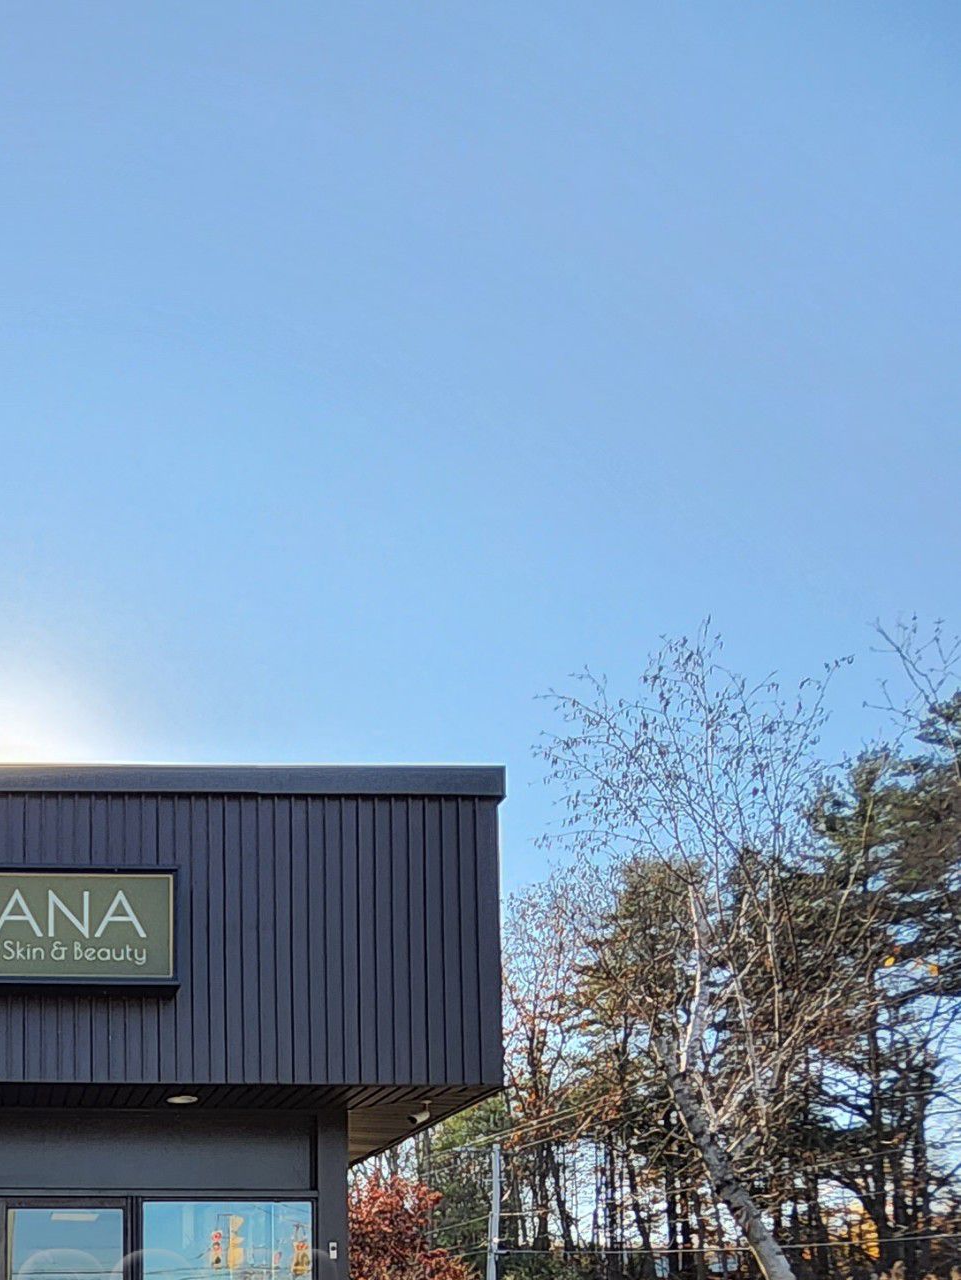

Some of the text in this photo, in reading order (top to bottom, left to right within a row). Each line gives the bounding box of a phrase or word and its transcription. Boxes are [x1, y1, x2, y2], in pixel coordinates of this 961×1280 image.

[2, 940, 45, 961] Skin
[50, 941, 68, 962] &
[73, 941, 147, 965] Beauty
